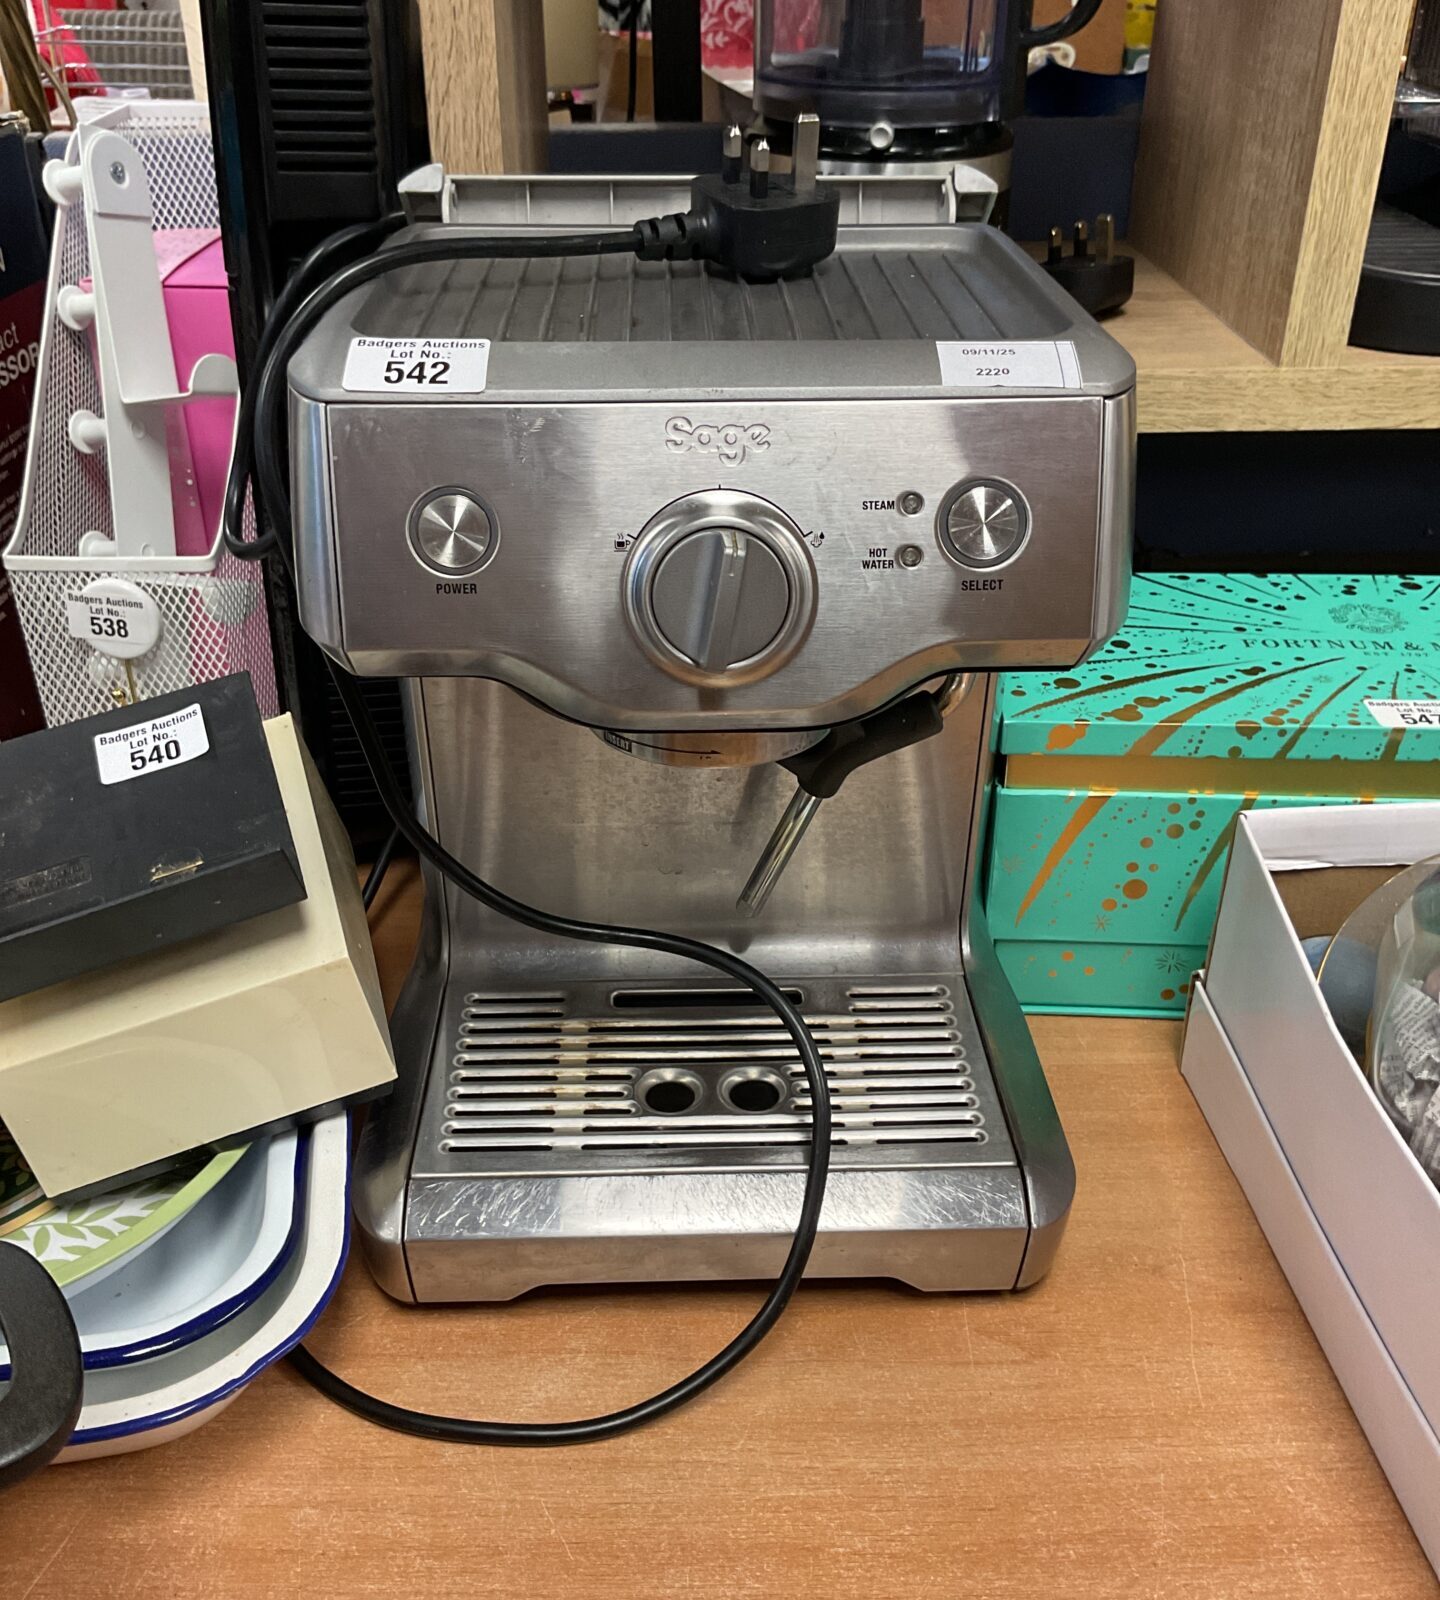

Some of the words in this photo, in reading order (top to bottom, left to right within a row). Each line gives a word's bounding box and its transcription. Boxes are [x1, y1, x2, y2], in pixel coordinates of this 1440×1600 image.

[358, 339, 417, 348] Badgers
[422, 340, 486, 349] Auctions
[390, 350, 414, 359] Lot
[962, 348, 1016, 356] 09/11/25
[384, 361, 451, 385] 542
[976, 367, 1010, 376] 2220
[664, 415, 772, 468] Sage
[862, 500, 895, 510] STEAM
[869, 548, 888, 558] HOT
[862, 560, 894, 569] WATER
[436, 583, 477, 594] POWER
[961, 579, 1004, 591] SELECT
[67, 592, 104, 605] Badgers
[106, 597, 144, 609] Auctions
[89, 606, 105, 616] Lot
[90, 616, 129, 638] 538
[1242, 638, 1396, 651] FORTNUM
[1403, 641, 1425, 651] &
[99, 727, 148, 747] Badgers
[151, 709, 199, 733] Auctions
[129, 737, 148, 749] Lot
[130, 739, 182, 771] 540
